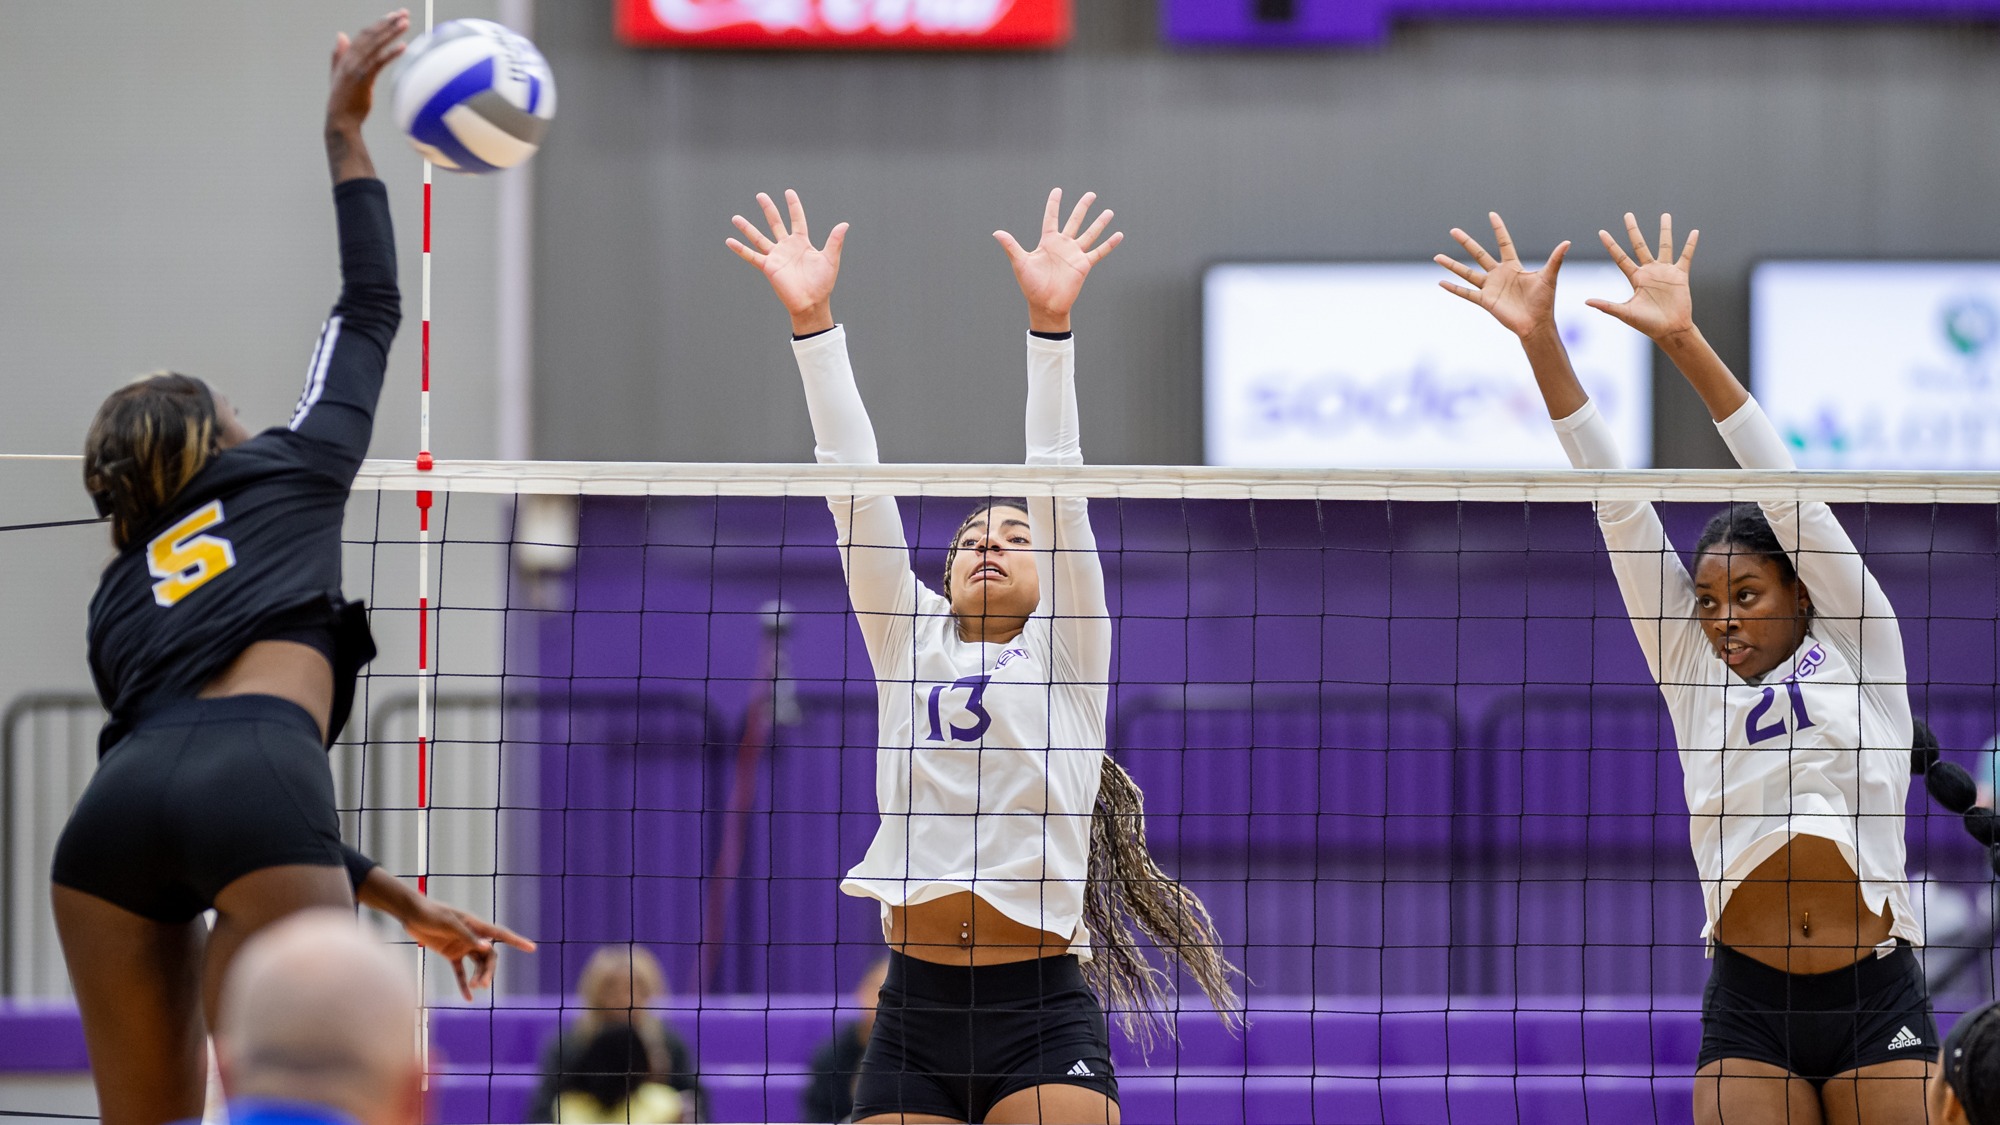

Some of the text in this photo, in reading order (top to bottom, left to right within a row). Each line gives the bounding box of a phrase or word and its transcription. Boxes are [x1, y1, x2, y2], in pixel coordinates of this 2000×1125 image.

[146, 499, 236, 608] 5
[925, 675, 992, 742] 13
[1745, 682, 1816, 745] 21
[1887, 1038, 1922, 1050] adidas
